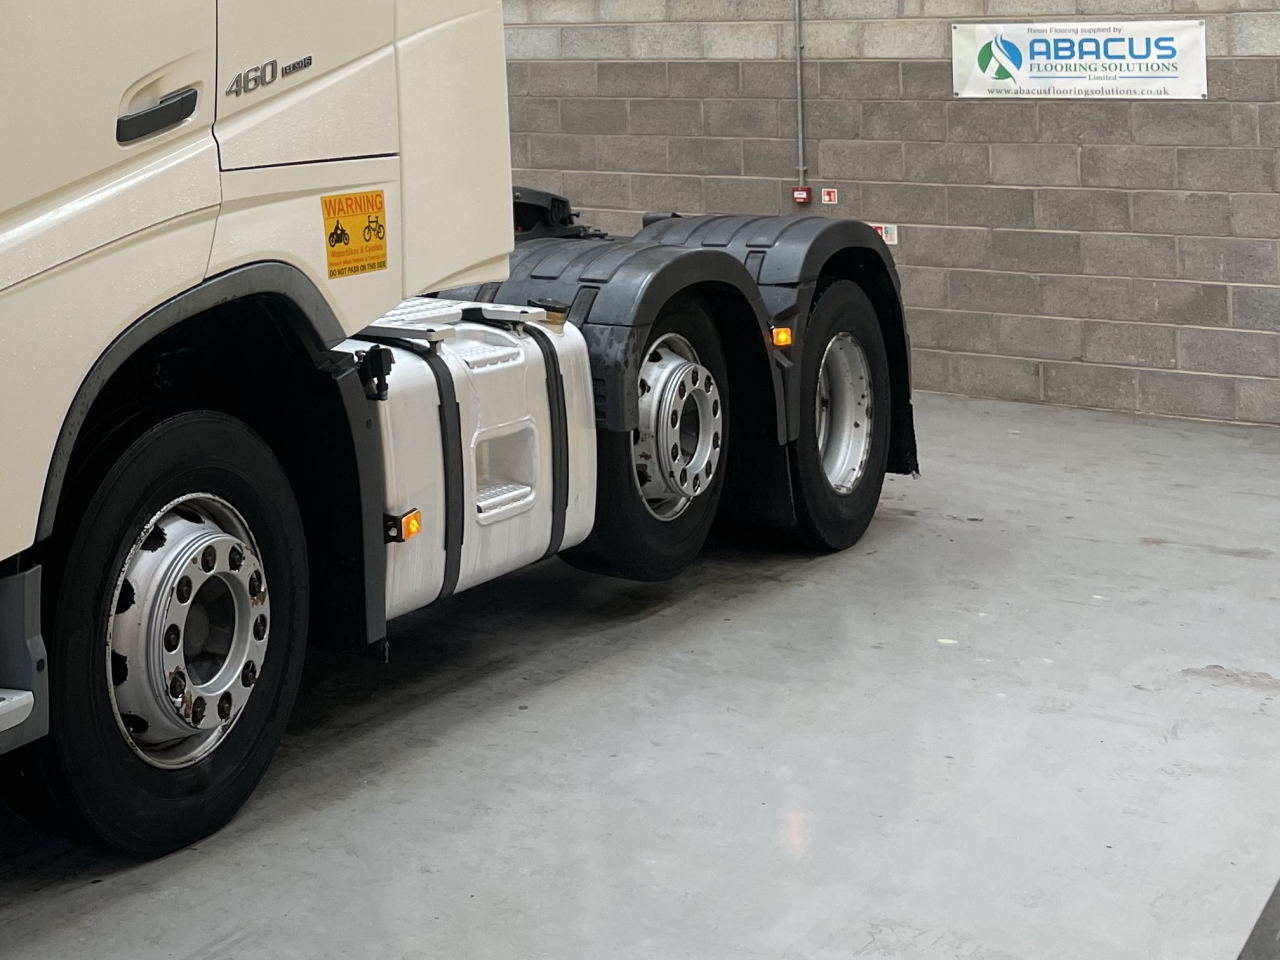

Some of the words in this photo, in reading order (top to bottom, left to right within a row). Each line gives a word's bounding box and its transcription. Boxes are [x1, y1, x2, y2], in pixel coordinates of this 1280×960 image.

[1049, 27, 1079, 35] Flooring
[1080, 27, 1112, 35] supplied
[1113, 26, 1122, 34] by
[1029, 36, 1177, 61] ABACUS
[1029, 63, 1098, 73] FLOORING
[1101, 62, 1179, 73] SOLUTIONS
[225, 58, 277, 97] 460
[988, 86, 1170, 98] www.abacusflooringsolutions.co.uk
[323, 193, 384, 217] WARNING
[329, 269, 337, 277] DO
[337, 268, 347, 276] NOT
[347, 265, 360, 274] PASS
[367, 262, 377, 270] THIS
[377, 261, 386, 269] SIDE
